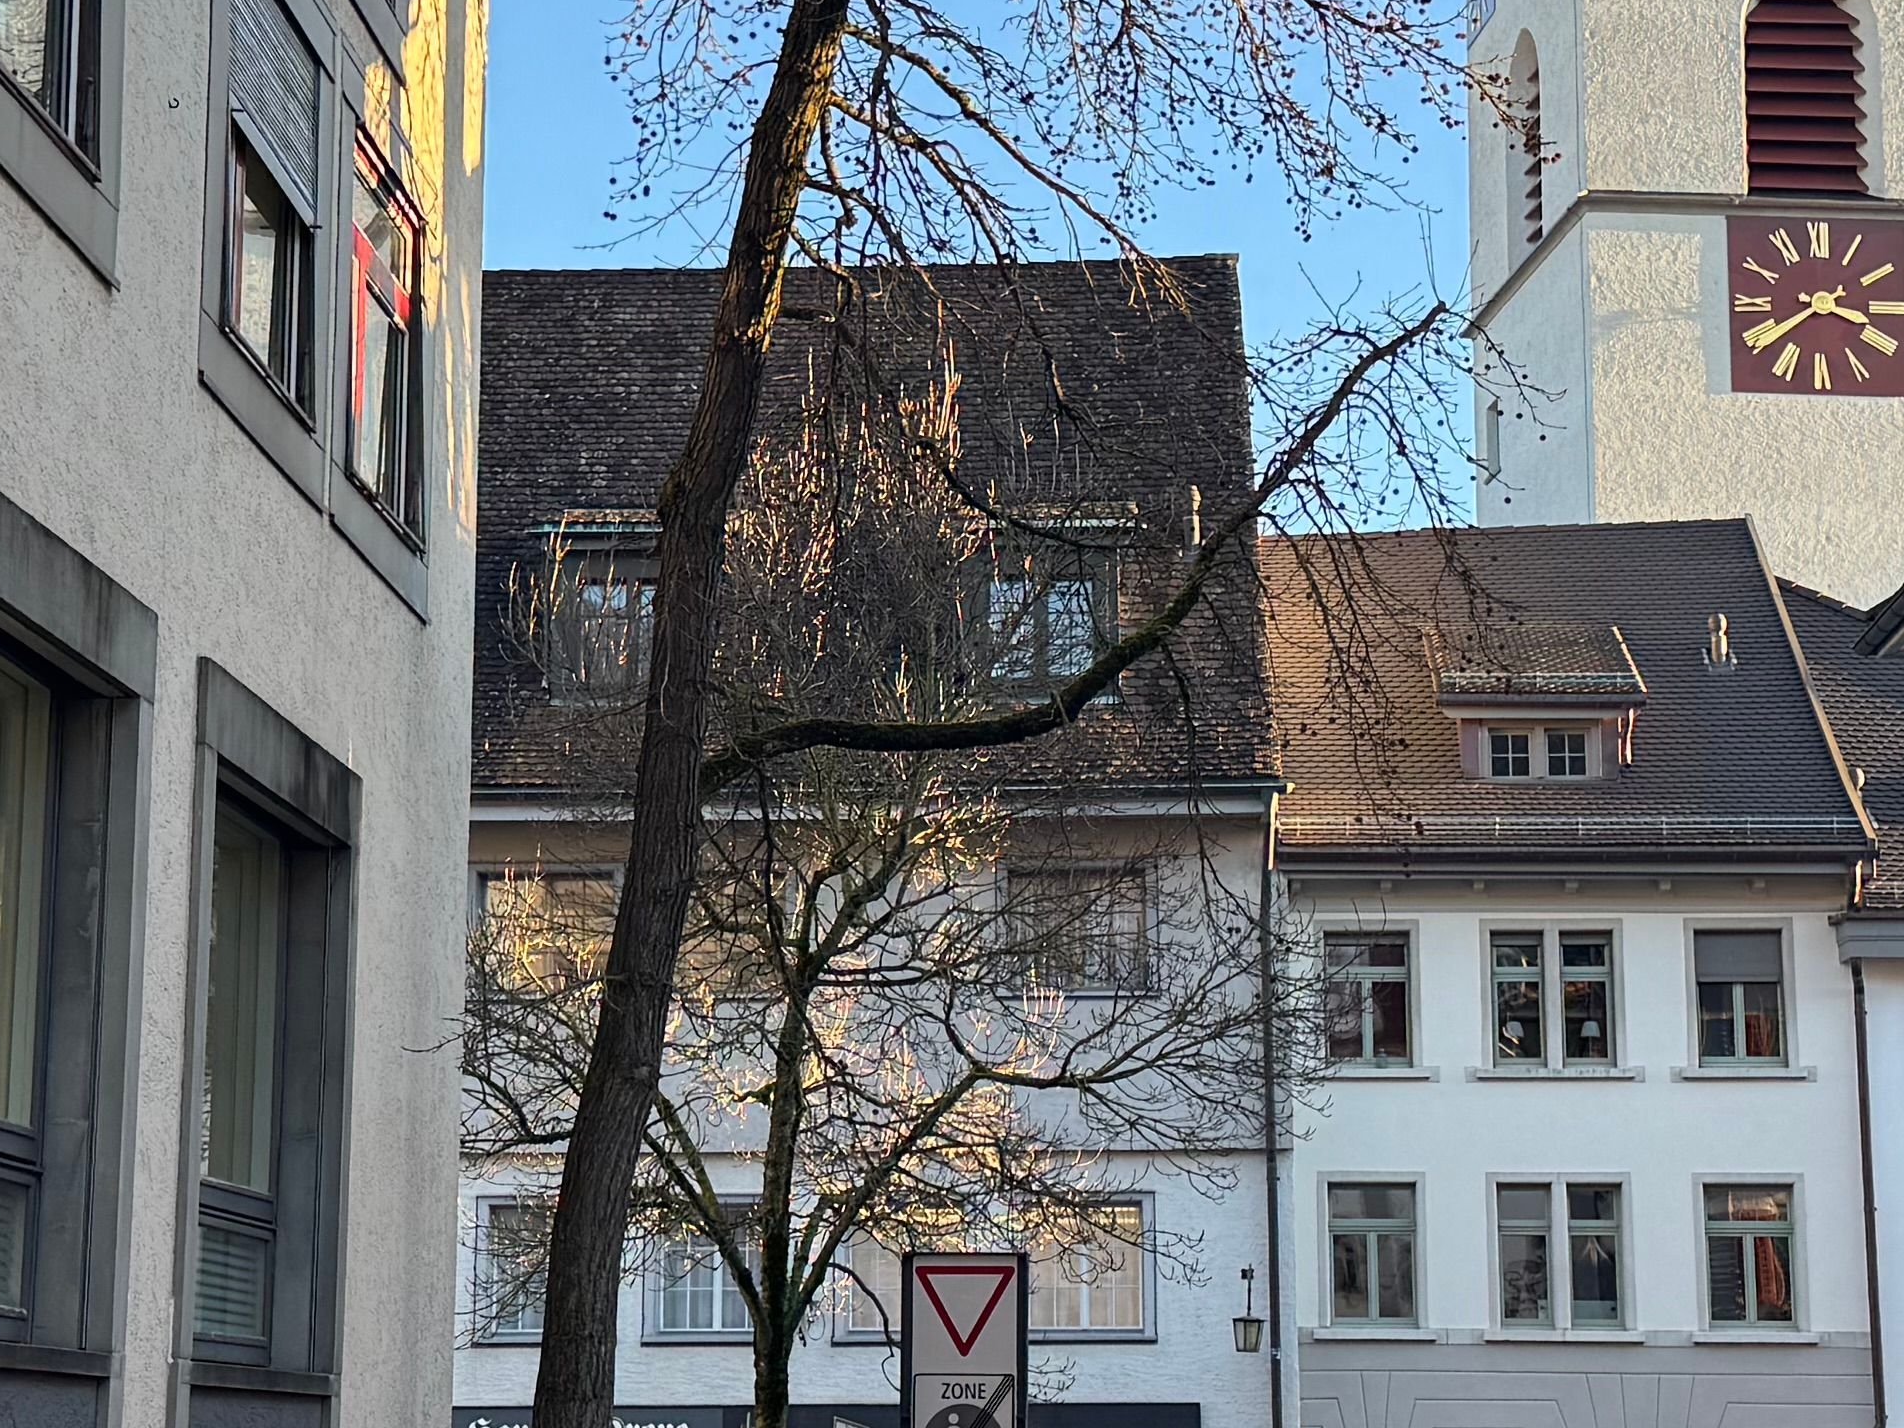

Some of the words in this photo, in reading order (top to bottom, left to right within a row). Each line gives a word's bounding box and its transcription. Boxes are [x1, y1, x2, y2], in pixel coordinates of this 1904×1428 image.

[1768, 227, 1801, 267] XI
[1806, 221, 1830, 259] XII
[1742, 256, 1780, 285] X
[941, 1382, 987, 1400] ZONE
